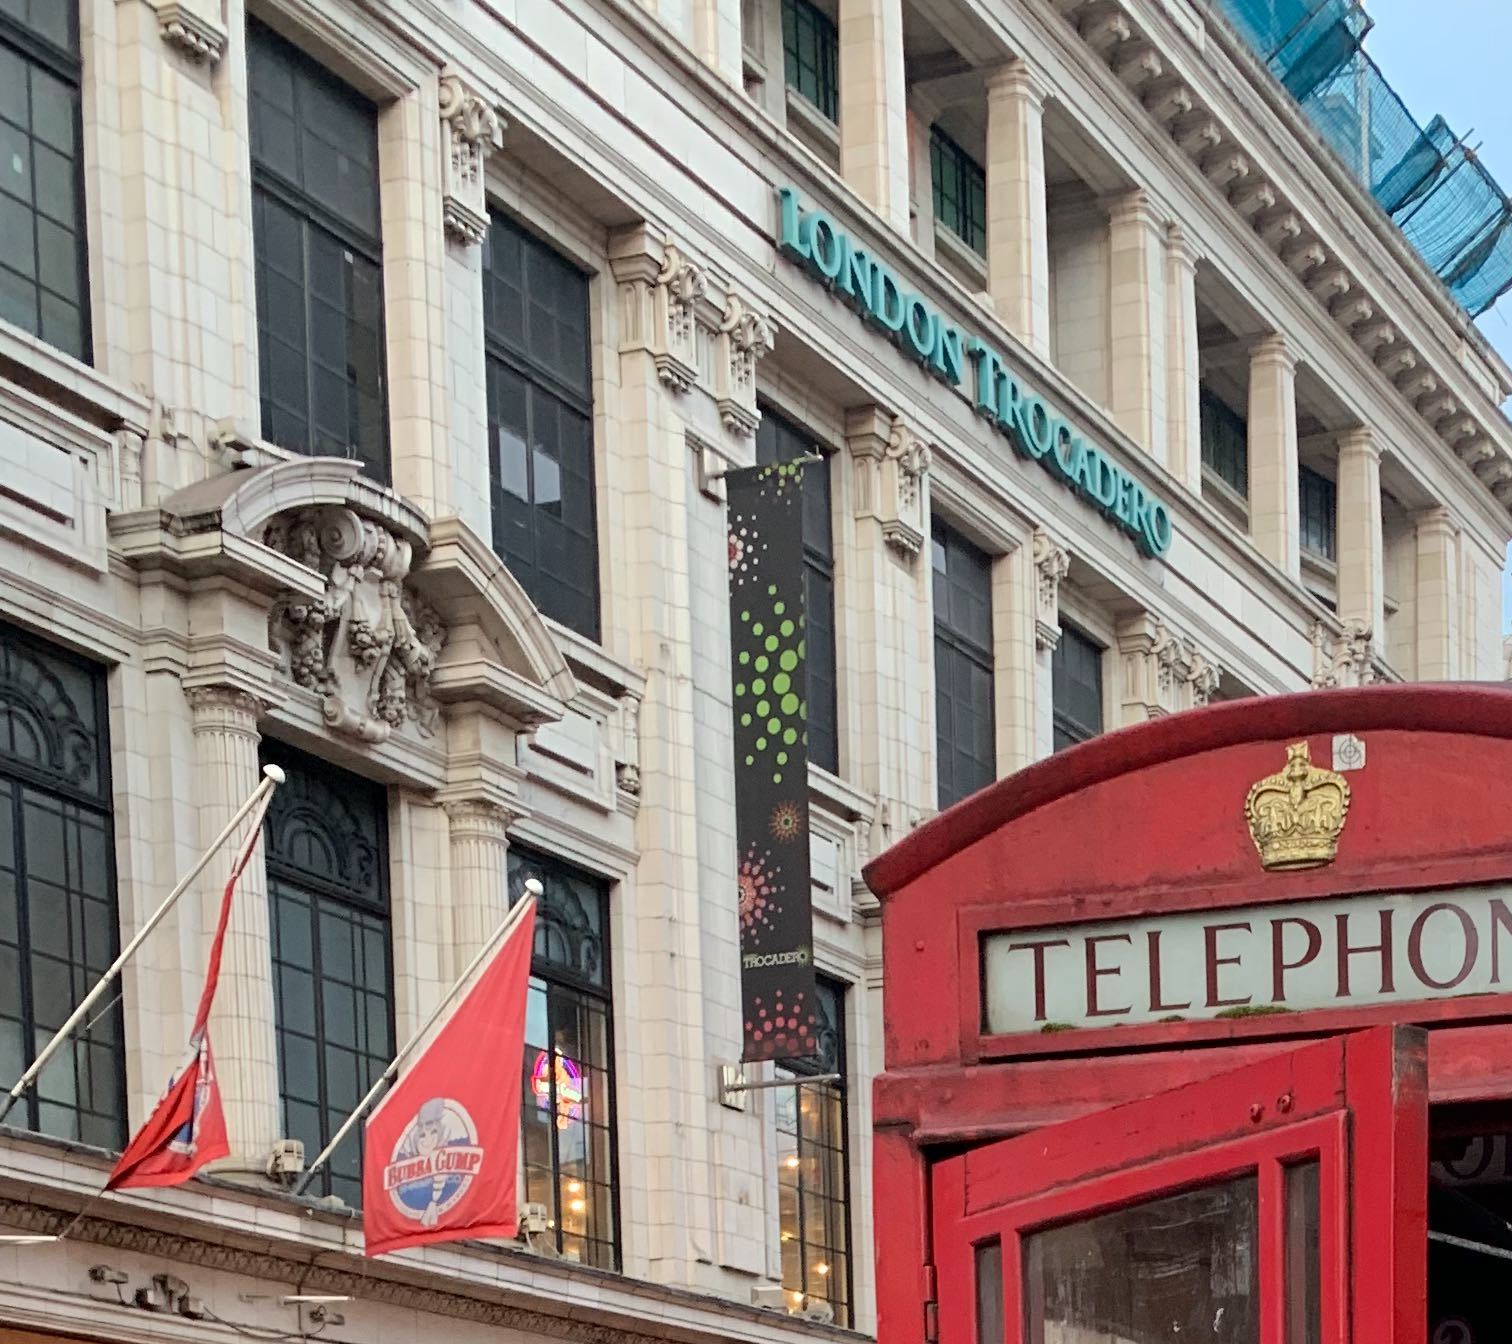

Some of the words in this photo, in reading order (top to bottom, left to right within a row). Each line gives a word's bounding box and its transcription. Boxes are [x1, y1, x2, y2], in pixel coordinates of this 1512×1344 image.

[779, 187, 963, 386] LONDON
[968, 338, 1172, 558] TROCADERO
[743, 951, 809, 969] TROCADERO
